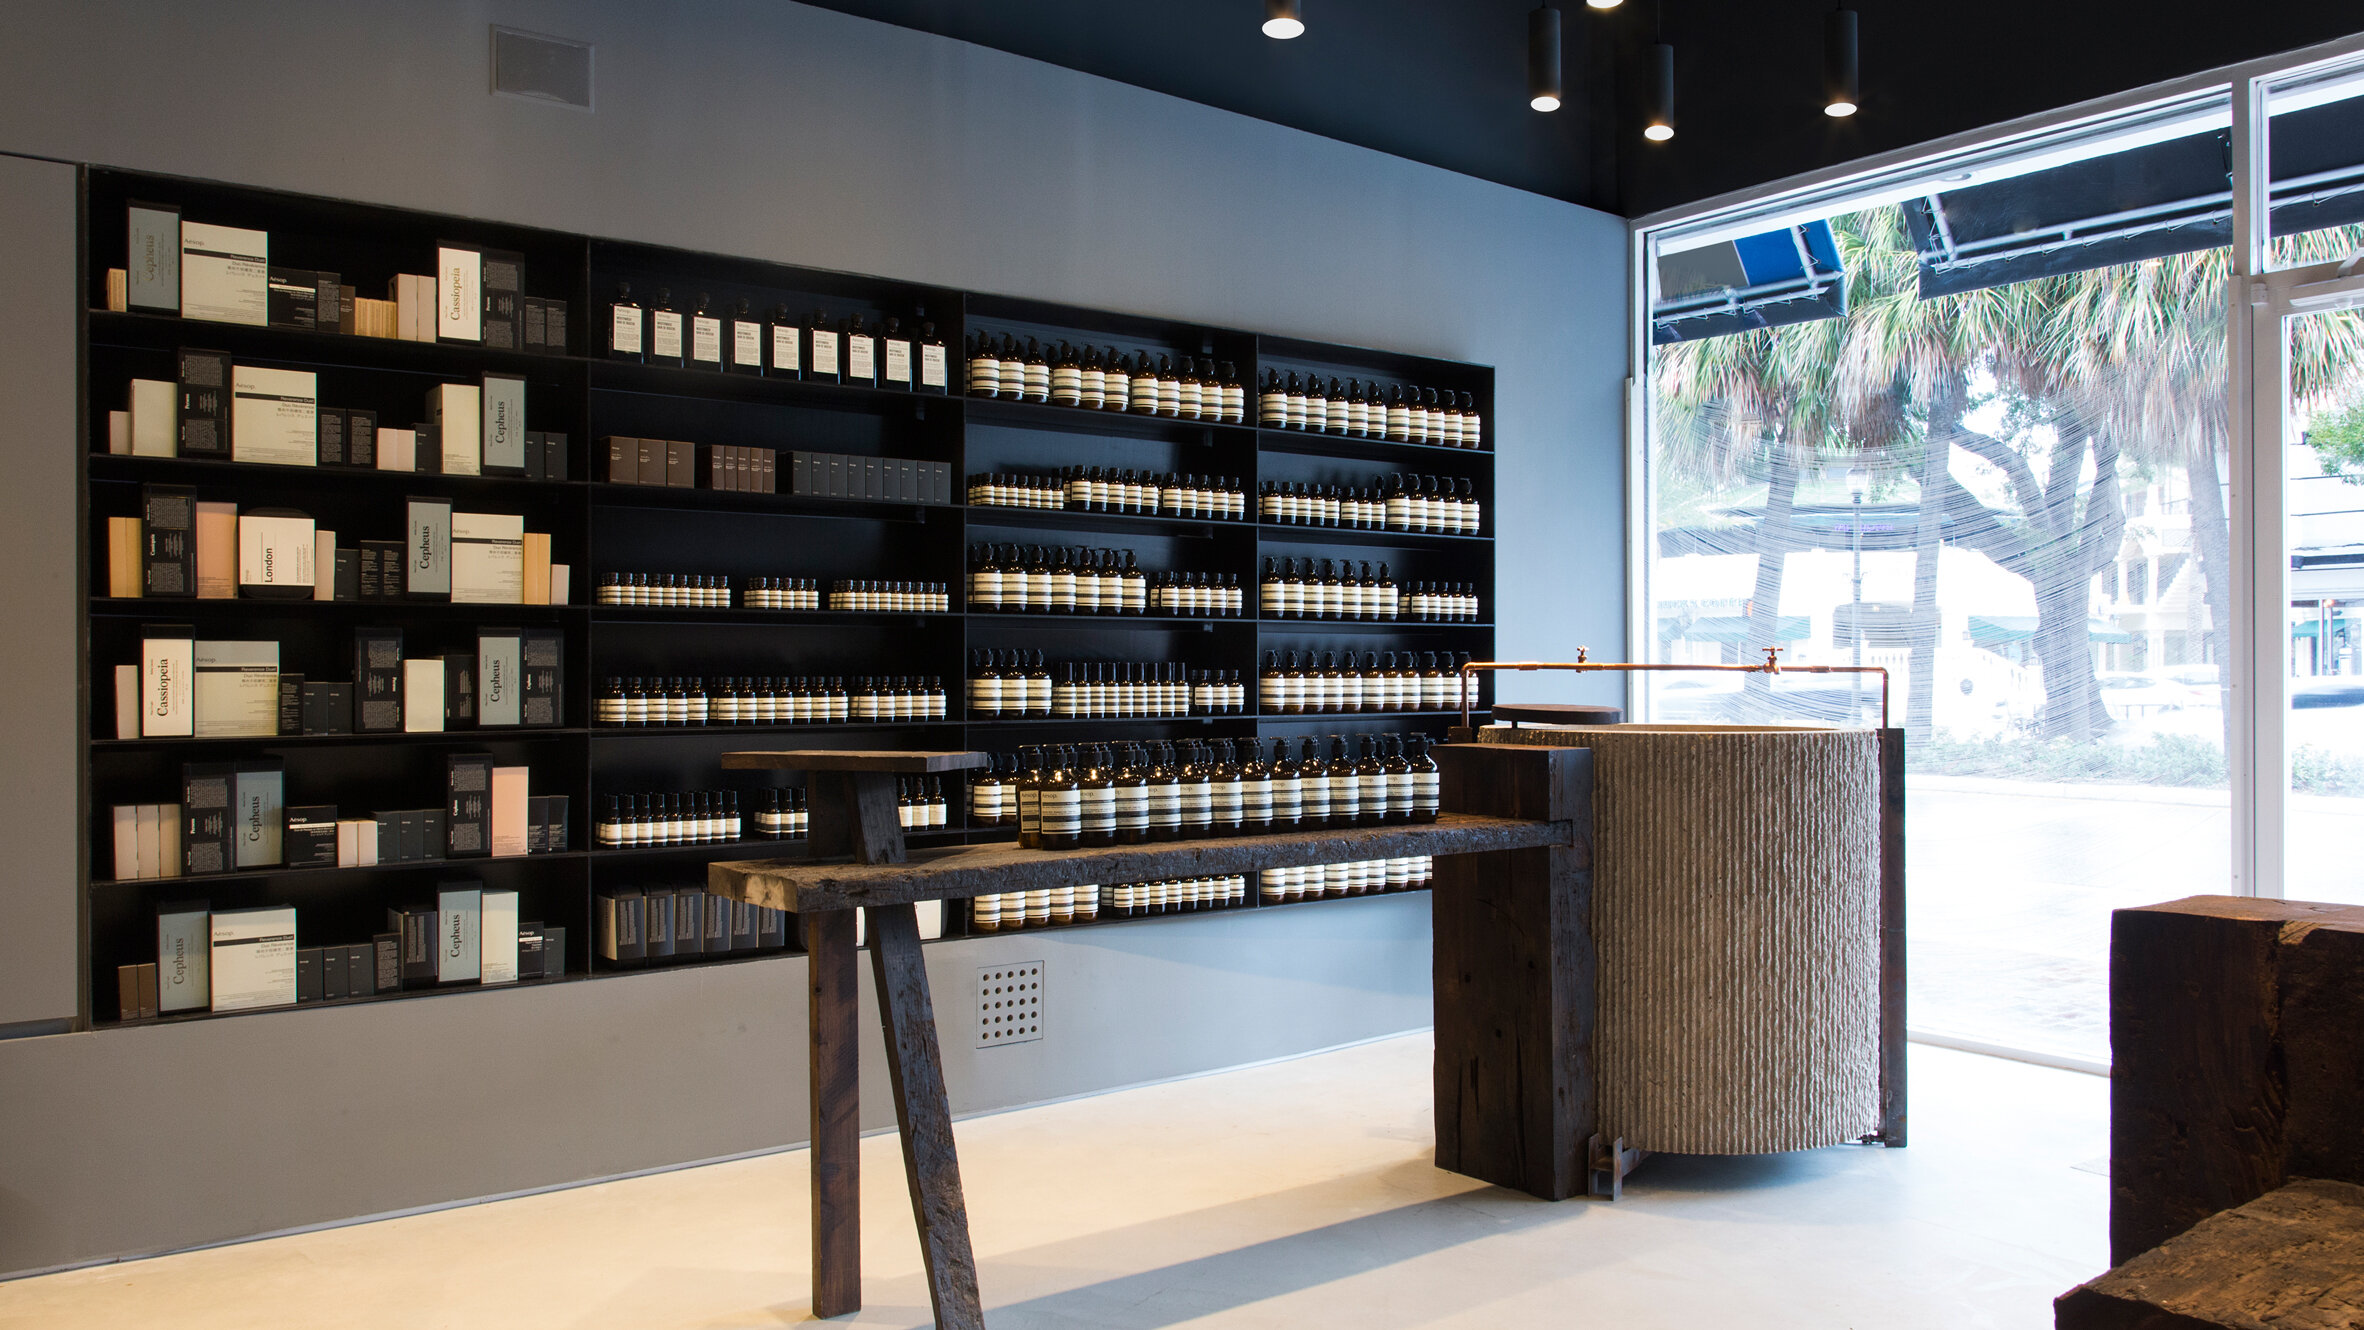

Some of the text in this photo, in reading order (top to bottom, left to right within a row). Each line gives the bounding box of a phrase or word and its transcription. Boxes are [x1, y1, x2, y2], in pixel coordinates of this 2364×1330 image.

[144, 235, 157, 281] Cepheus
[450, 267, 462, 320] Cassiopeia
[495, 401, 507, 444] Cepheus
[264, 548, 273, 582] London
[419, 525, 432, 569] Cepheus
[157, 658, 171, 717] Cassiopeia
[490, 659, 503, 703] Cepheus
[249, 796, 262, 842] Cepheus
[450, 914, 463, 958] Cepheus
[173, 937, 187, 985] Cepheus
